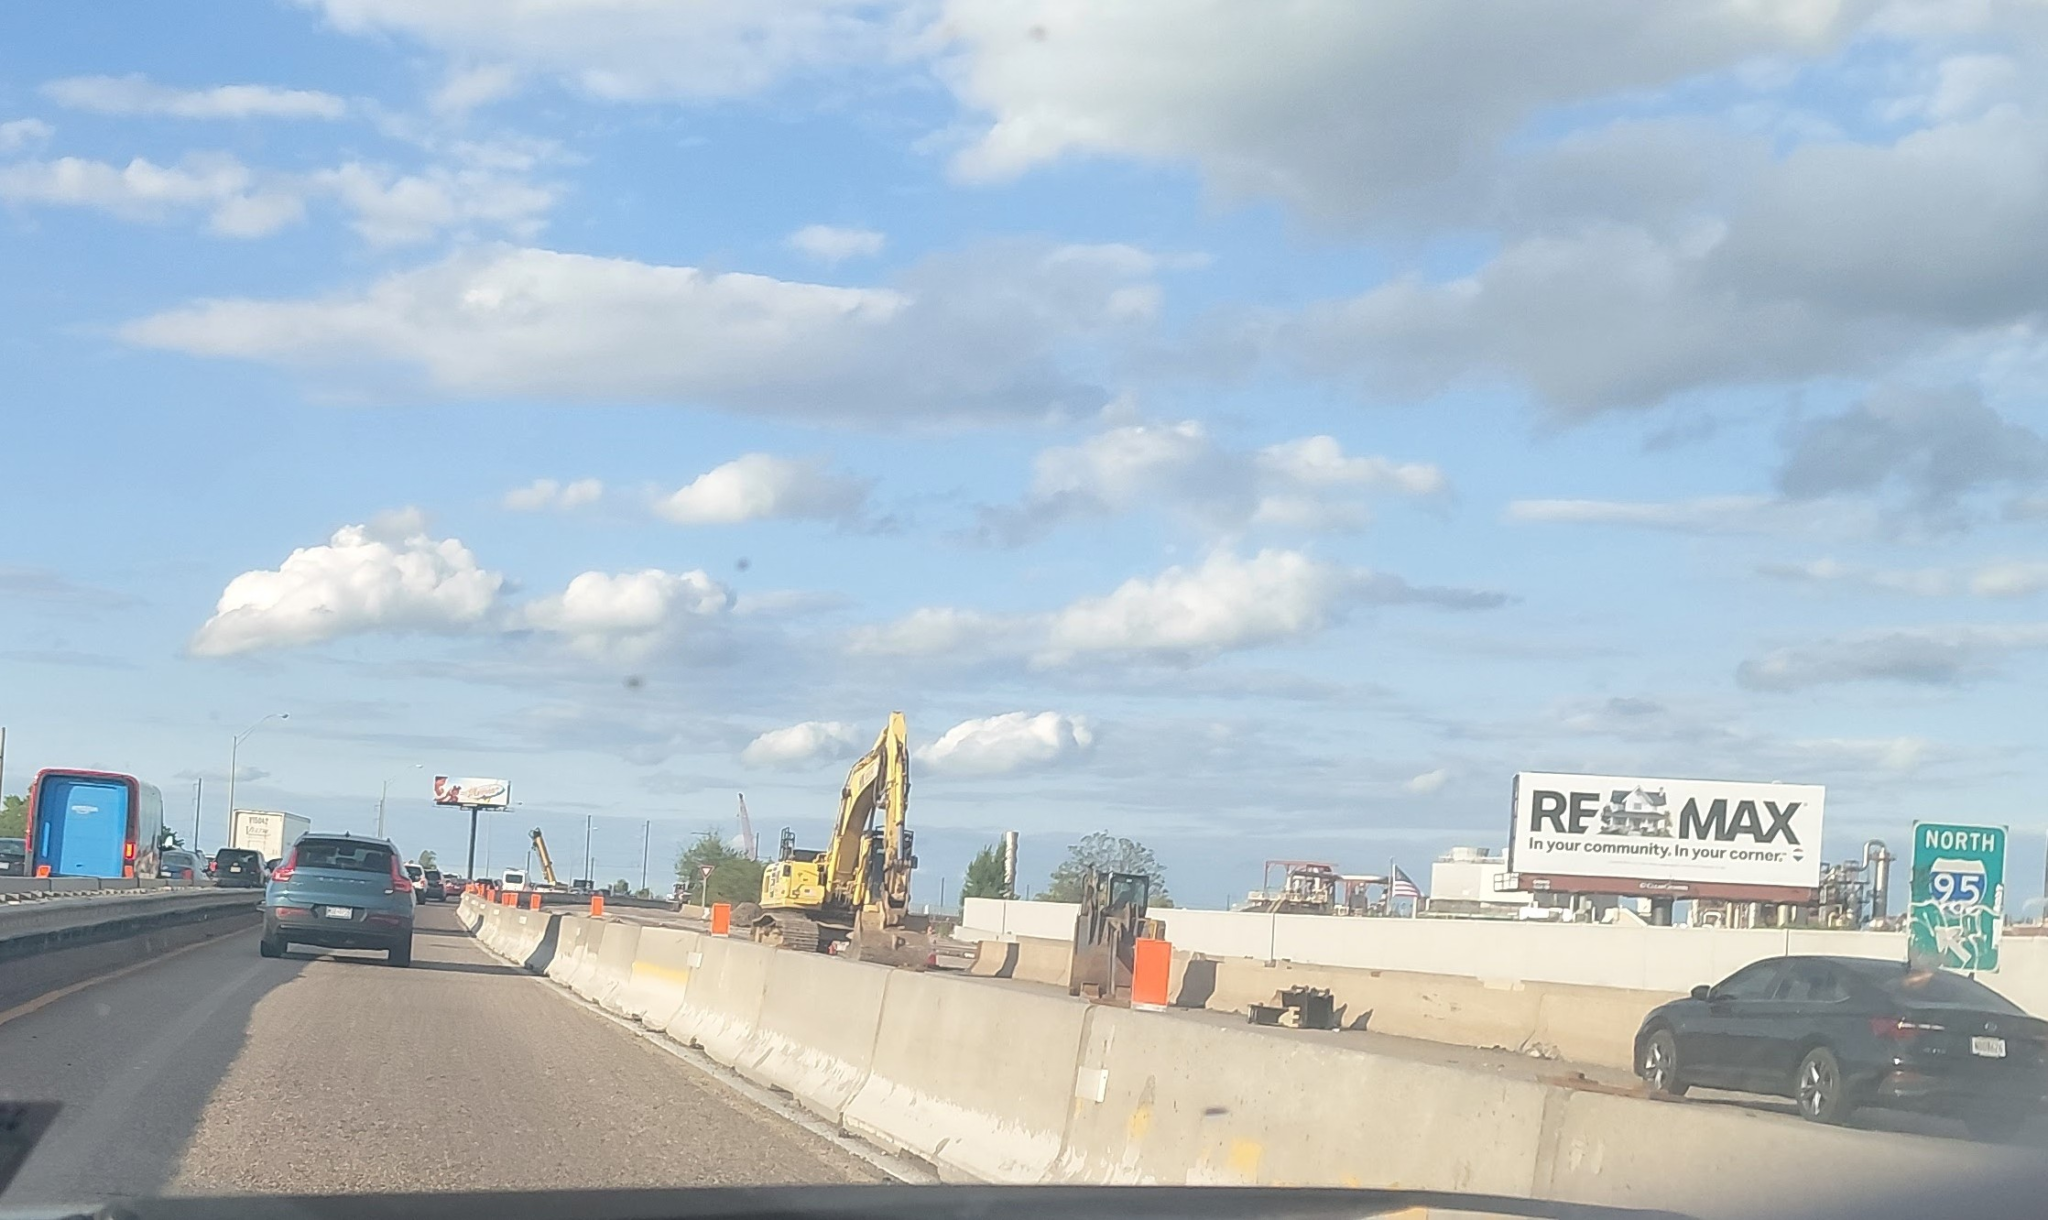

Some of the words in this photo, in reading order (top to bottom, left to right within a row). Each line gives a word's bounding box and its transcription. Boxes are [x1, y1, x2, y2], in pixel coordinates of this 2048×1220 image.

[1530, 790, 1600, 834] RE
[1679, 797, 1802, 845] MAX
[1529, 837, 1543, 850] In
[1546, 841, 1582, 854] your
[1584, 842, 1672, 859] community.
[1675, 844, 1689, 857] In
[1692, 848, 1727, 861] your
[1926, 830, 1995, 852] NORTH
[1934, 873, 1981, 905] 95
